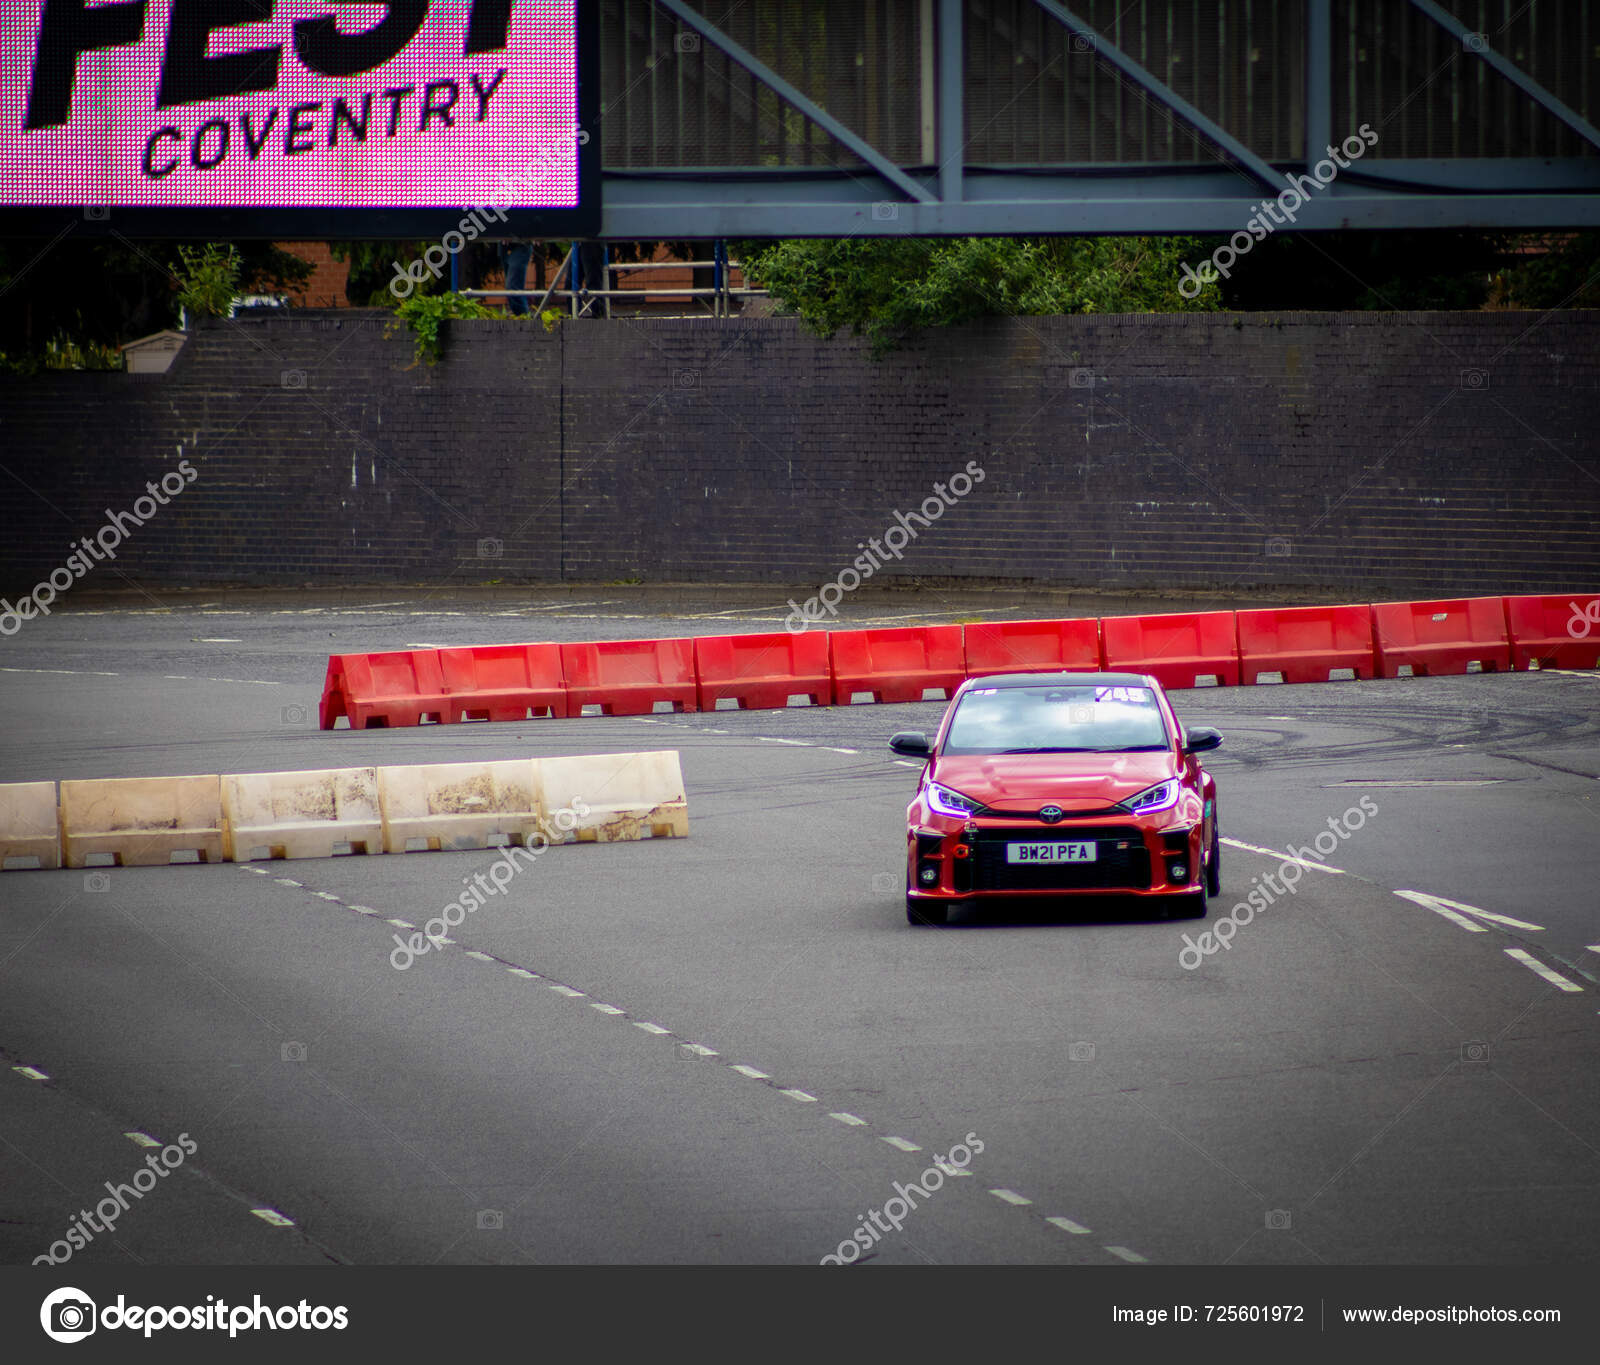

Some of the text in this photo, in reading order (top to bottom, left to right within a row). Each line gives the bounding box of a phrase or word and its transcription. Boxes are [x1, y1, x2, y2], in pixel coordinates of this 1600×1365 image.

[23, 0, 512, 131] FE
[142, 69, 508, 179] COVENTRY
[1019, 844, 1088, 860] BW21 PFA
